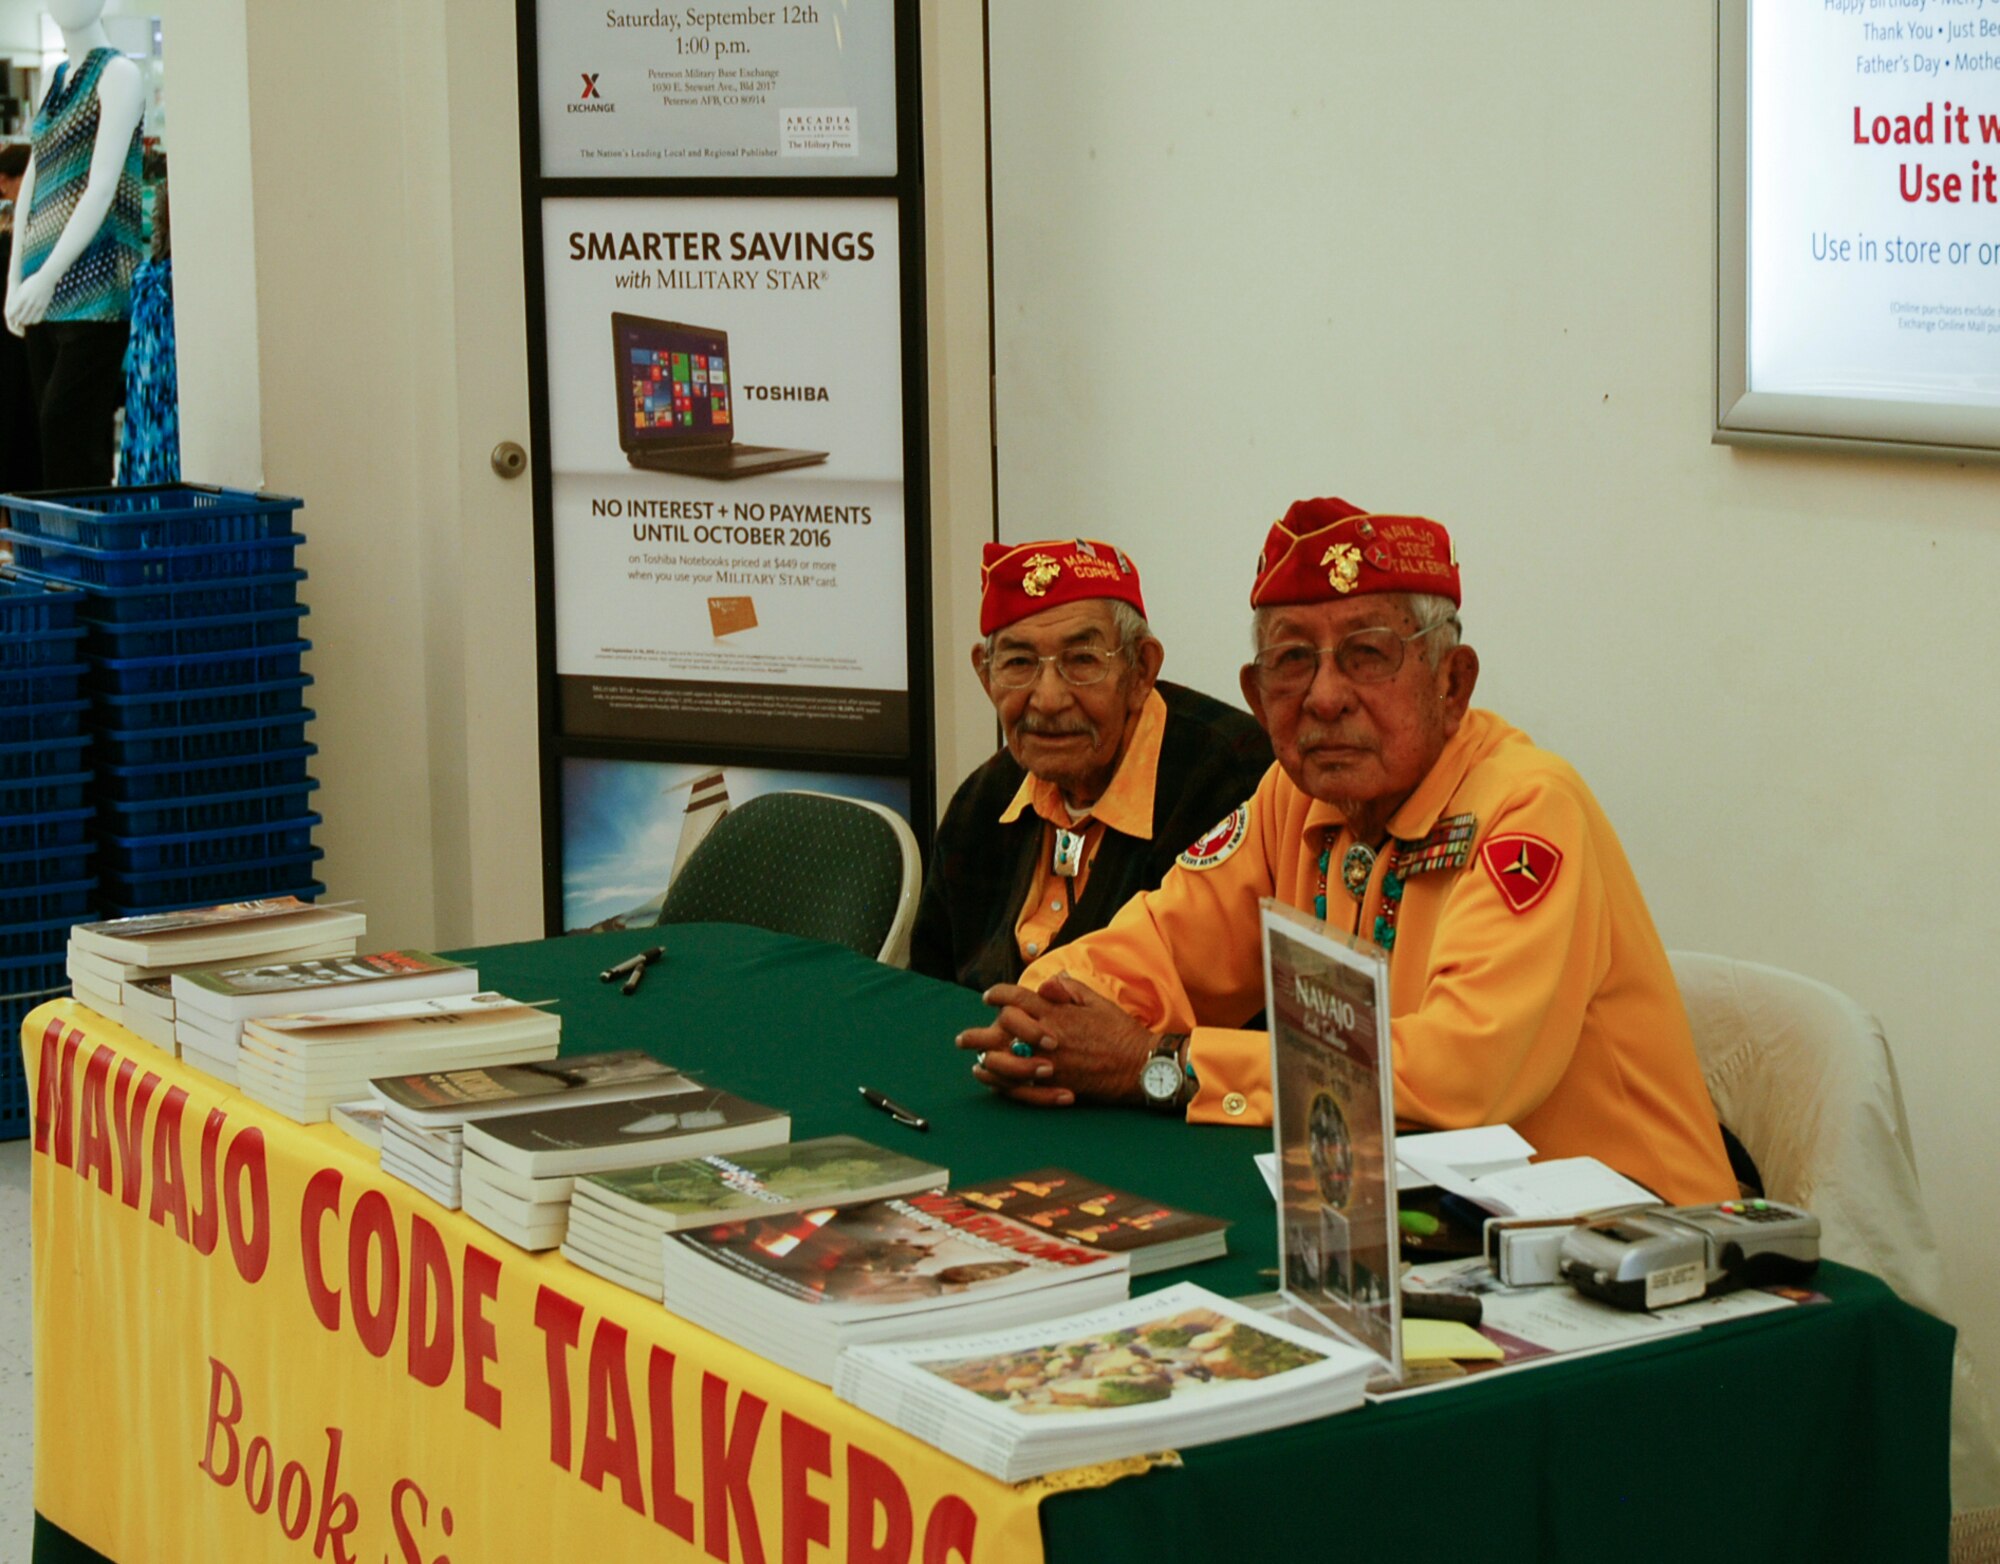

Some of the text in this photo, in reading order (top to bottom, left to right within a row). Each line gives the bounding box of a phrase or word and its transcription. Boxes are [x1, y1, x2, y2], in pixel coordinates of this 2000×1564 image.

[606, 5, 819, 32] Saturday, September 12th
[1864, 22, 1904, 40] Thank
[1908, 21, 1934, 40] You
[1947, 20, 1975, 43] Just
[676, 36, 750, 59] 1:00 p.m.
[648, 68, 780, 80] Peterson Military Base Exchange
[1856, 54, 1909, 73] Father's
[1914, 54, 1941, 78] Day
[685, 82, 715, 92] Stewart
[740, 82, 754, 91] Bld
[756, 82, 776, 91] 2017
[567, 103, 616, 114] EXCHANGE
[664, 96, 698, 106] Peterson
[724, 95, 738, 105] CO
[786, 116, 850, 124] ARCADIA
[1854, 102, 1934, 144] Load
[1944, 102, 1970, 144] it
[580, 148, 778, 159] The Nation's Leading Local and Regional Publisher
[788, 140, 852, 150] The History Press
[1900, 160, 1998, 204] Use it
[568, 232, 876, 262] SMARTER SAVINGS
[1812, 232, 1851, 262] Use
[1858, 233, 1877, 262] in
[1885, 234, 1941, 264] store
[1948, 240, 1972, 265] or
[616, 270, 652, 290] with
[657, 268, 760, 290] MILITARY
[1922, 303, 1962, 316] purchases
[1964, 304, 1996, 317] exclude
[1898, 317, 1936, 333] Exchange
[1938, 319, 1966, 332] Online
[744, 386, 830, 402] TOSHIBA
[592, 499, 622, 518] NO
[627, 500, 714, 520] INTEREST
[734, 503, 765, 522] NO
[770, 504, 872, 525] PAYMENTS
[633, 524, 831, 548] UNTIL OCTOBER 2016
[1380, 525, 1435, 546] NAVAJO
[628, 554, 837, 571] on Toshiba Notebooks priced at $449 or more
[1063, 554, 1116, 570] MARINE
[627, 570, 653, 580] when
[655, 572, 672, 584] you
[674, 572, 690, 582] use
[692, 574, 713, 585] your
[716, 570, 776, 586] MILITARY
[1294, 974, 1356, 1032] NAVAJO
[34, 1018, 270, 1284] NAVAJO
[300, 1168, 502, 1429] CODE
[198, 1356, 359, 1564] Book
